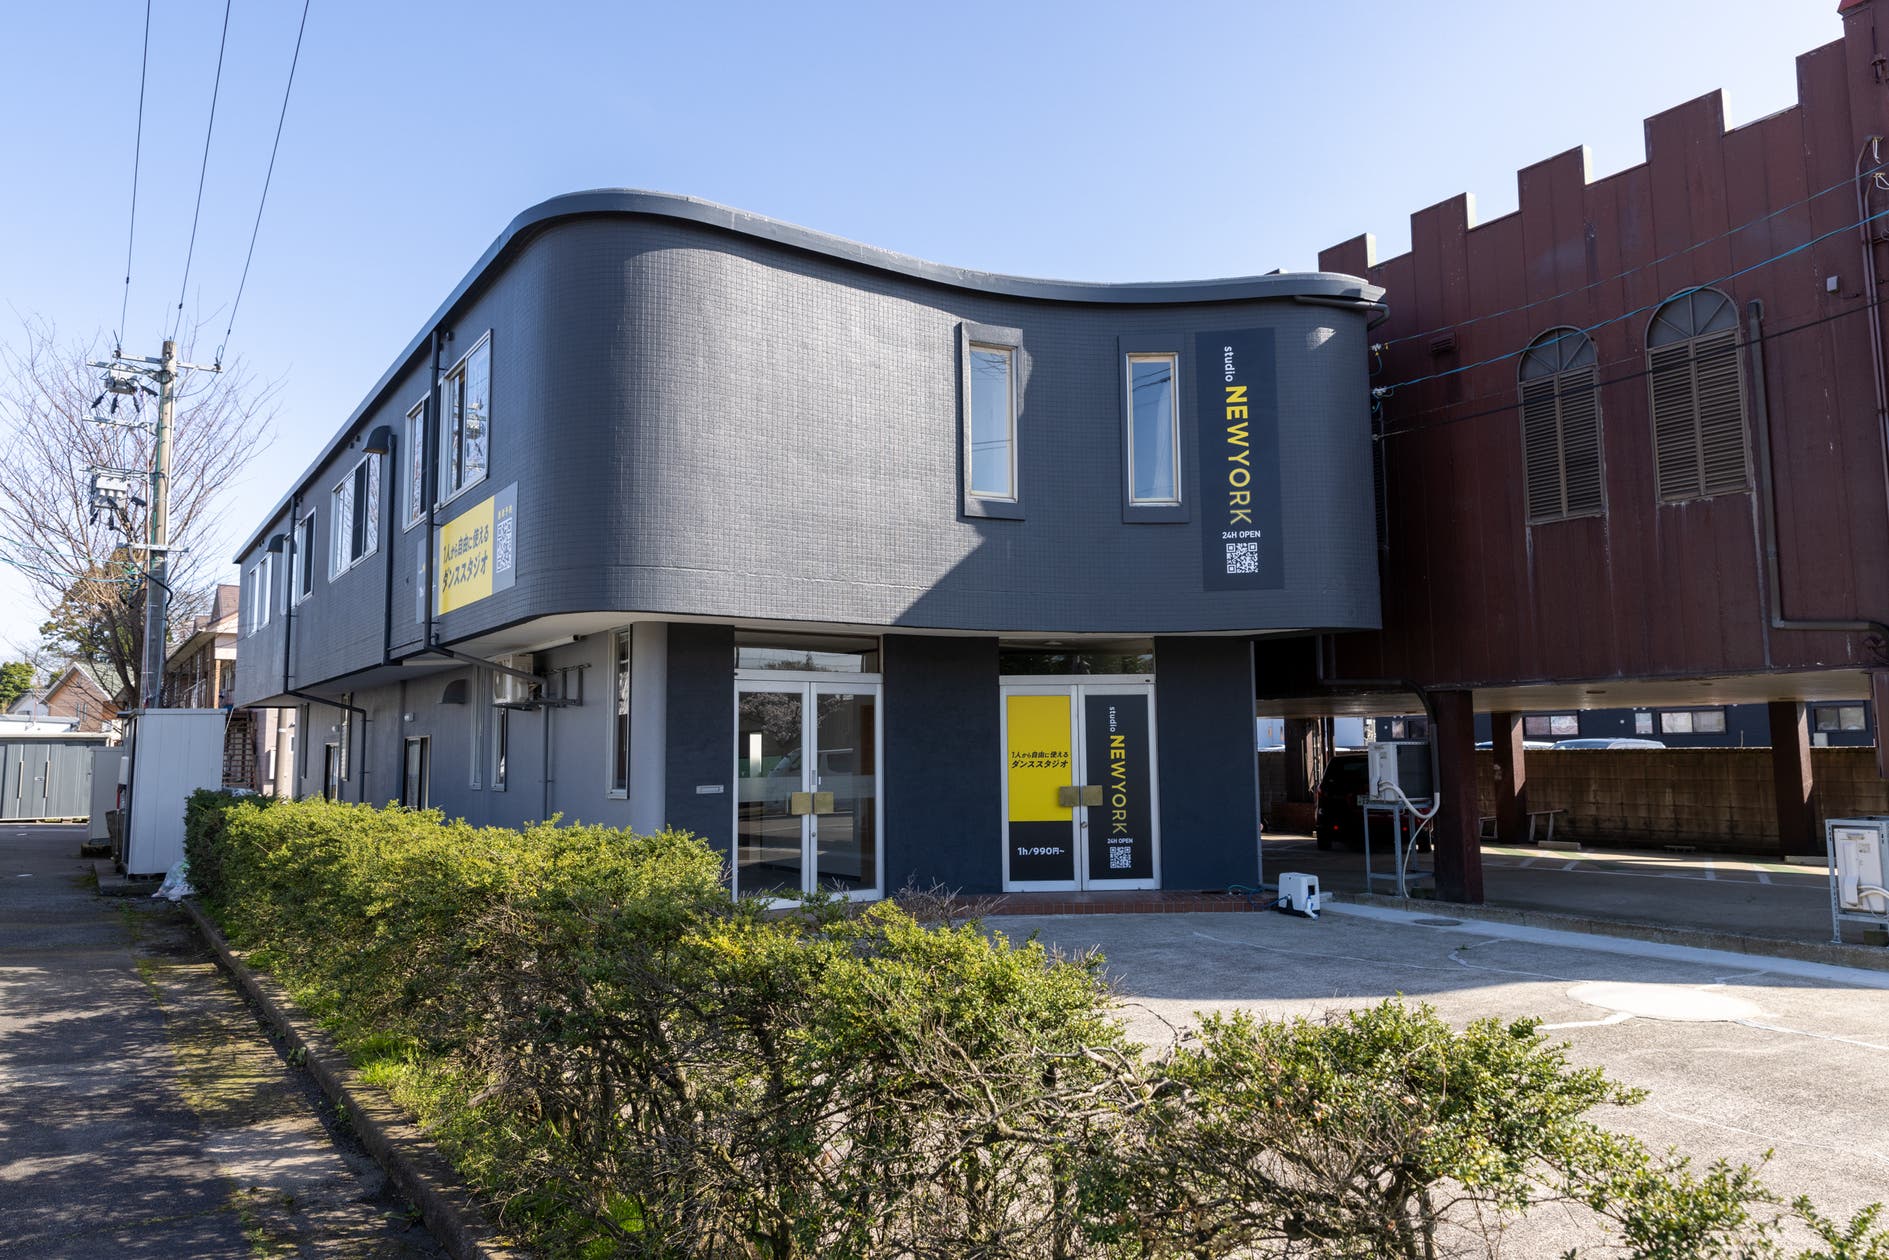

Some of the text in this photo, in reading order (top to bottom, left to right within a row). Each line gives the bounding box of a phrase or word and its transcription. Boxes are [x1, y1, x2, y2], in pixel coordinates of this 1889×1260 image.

[1224, 346, 1235, 382] studio
[443, 524, 489, 564] 1人から自由に使える
[442, 550, 488, 593] ダンススタジオ
[1109, 706, 1117, 732] studio
[1011, 760, 1068, 768] ダンススタジオ
